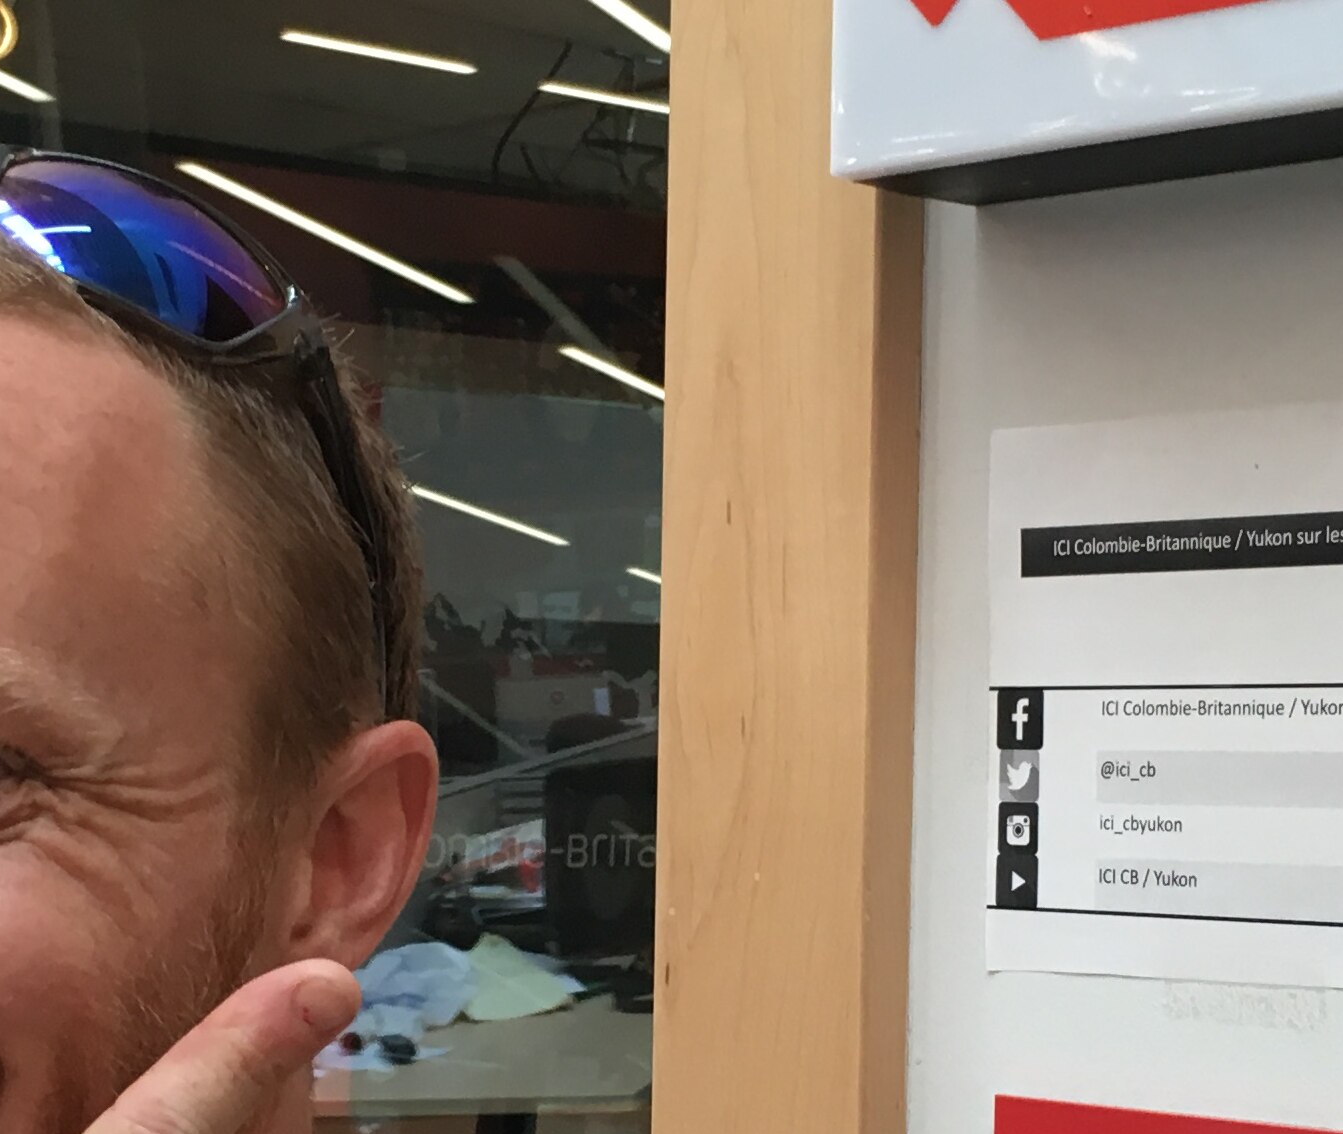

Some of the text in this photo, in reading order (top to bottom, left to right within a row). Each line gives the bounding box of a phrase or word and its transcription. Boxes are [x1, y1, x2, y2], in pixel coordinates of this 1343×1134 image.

[1053, 540, 1071, 556] ICI
[1074, 532, 1232, 556] Colombie-Britannique
[1234, 529, 1244, 551] /
[1246, 528, 1293, 548] Yukon
[1296, 530, 1322, 545] sur
[1101, 700, 1119, 716] ICI
[1122, 699, 1285, 719] Colombie-Britannique
[1288, 697, 1298, 718] /
[1100, 760, 1157, 782] @ici_cb
[1099, 814, 1183, 835] ici_cbyukon
[1099, 867, 1198, 888] ICI CB / Yukon
